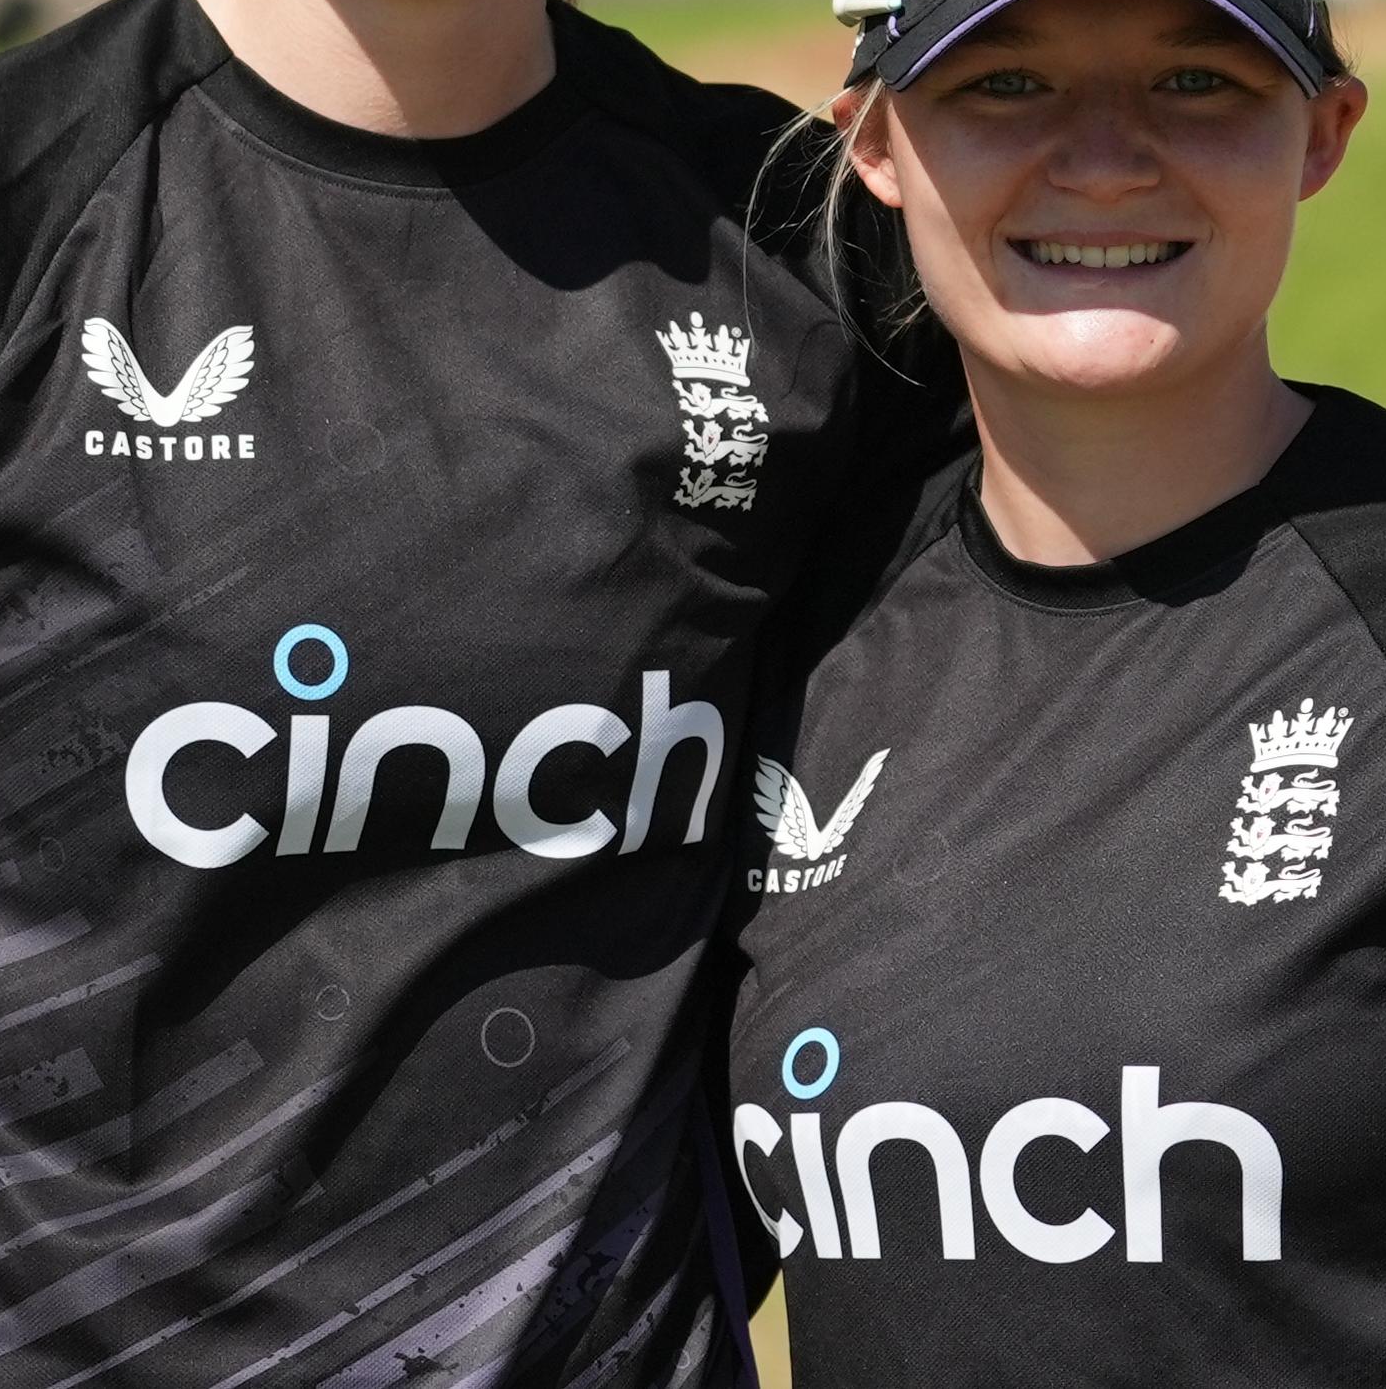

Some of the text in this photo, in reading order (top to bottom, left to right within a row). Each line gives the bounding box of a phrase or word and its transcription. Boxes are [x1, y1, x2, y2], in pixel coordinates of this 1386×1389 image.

[85, 429, 255, 461] CASTORE
[125, 623, 726, 869] cinch
[747, 854, 848, 893] CASTORE
[732, 1027, 1283, 1264] cinch
